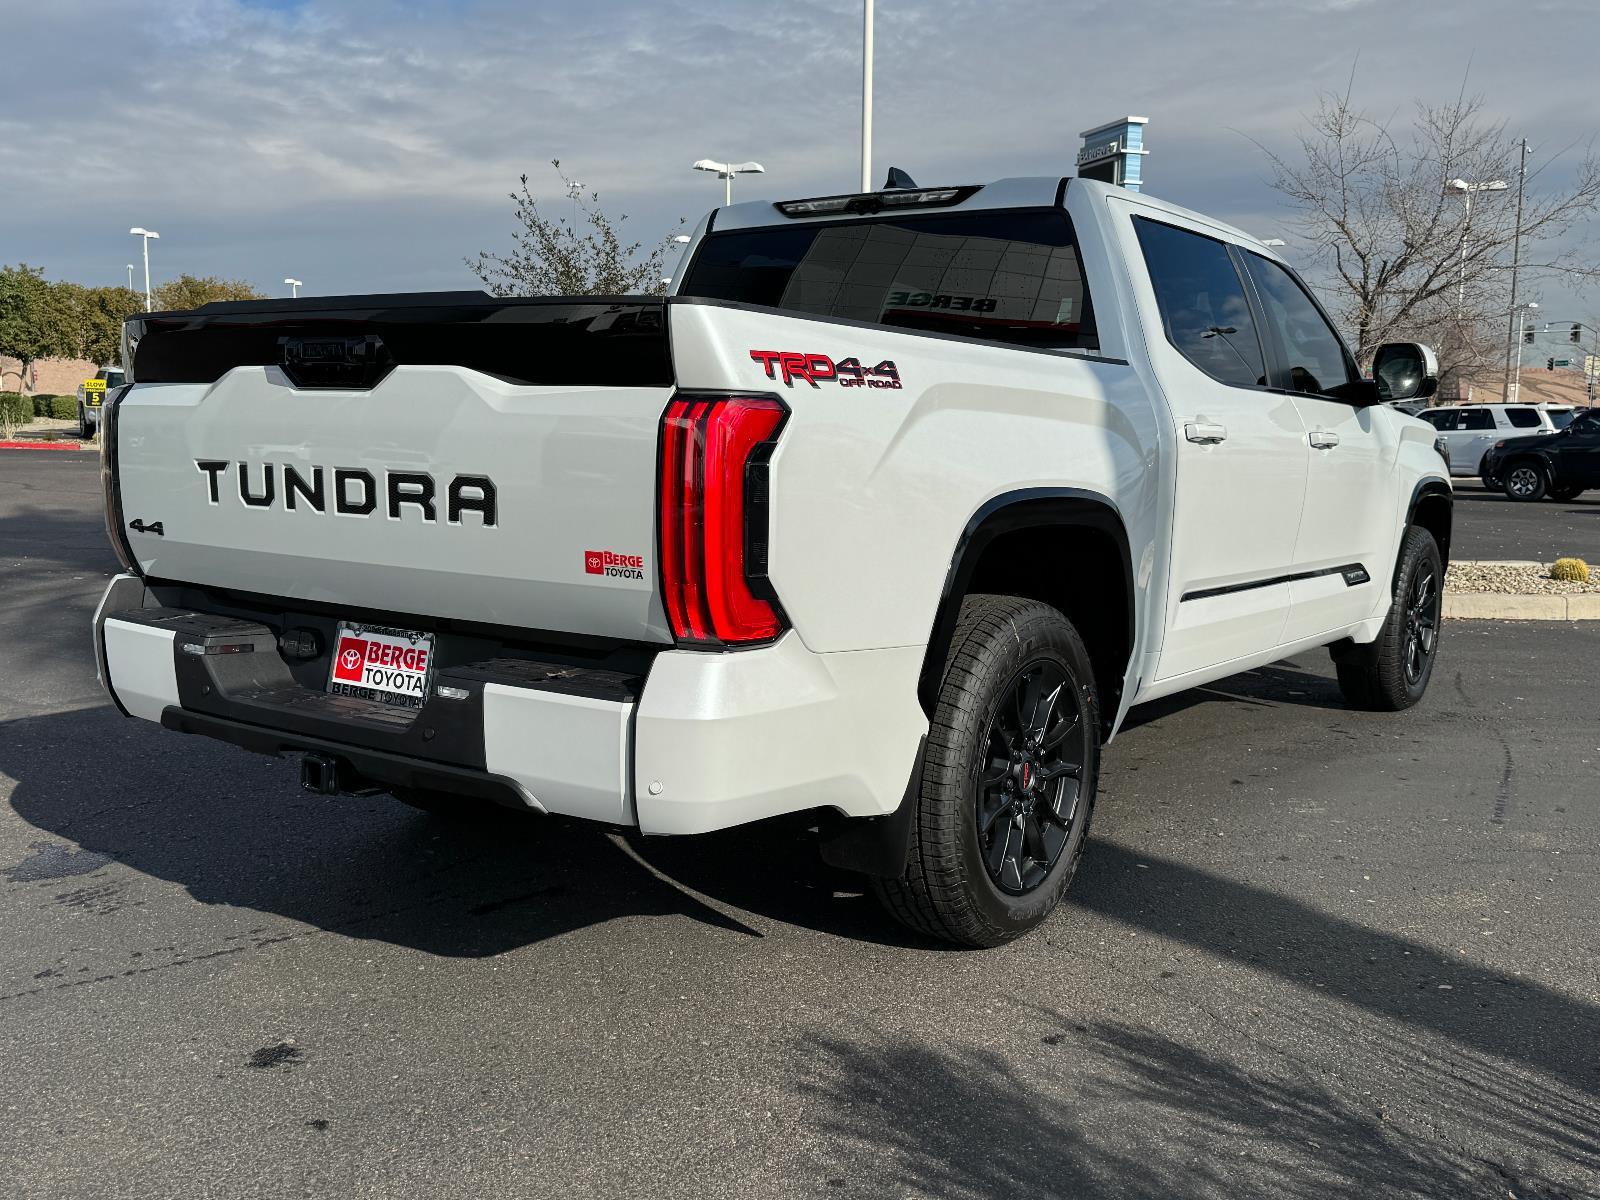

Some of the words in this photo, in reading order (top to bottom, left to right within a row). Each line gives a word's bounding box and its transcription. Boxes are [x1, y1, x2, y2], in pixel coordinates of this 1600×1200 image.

[749, 349, 838, 390] TRD
[839, 378, 865, 388] OFF
[868, 379, 902, 389] ROAD
[92, 392, 100, 402] 5
[194, 459, 498, 528] TUNDRA
[603, 551, 643, 568] BERGE
[605, 567, 644, 580] TOYOTA
[367, 641, 428, 672] BERGE
[365, 668, 423, 693] TOYOTA
[332, 683, 376, 700] BERGE
[380, 691, 421, 708] TOYOTA
